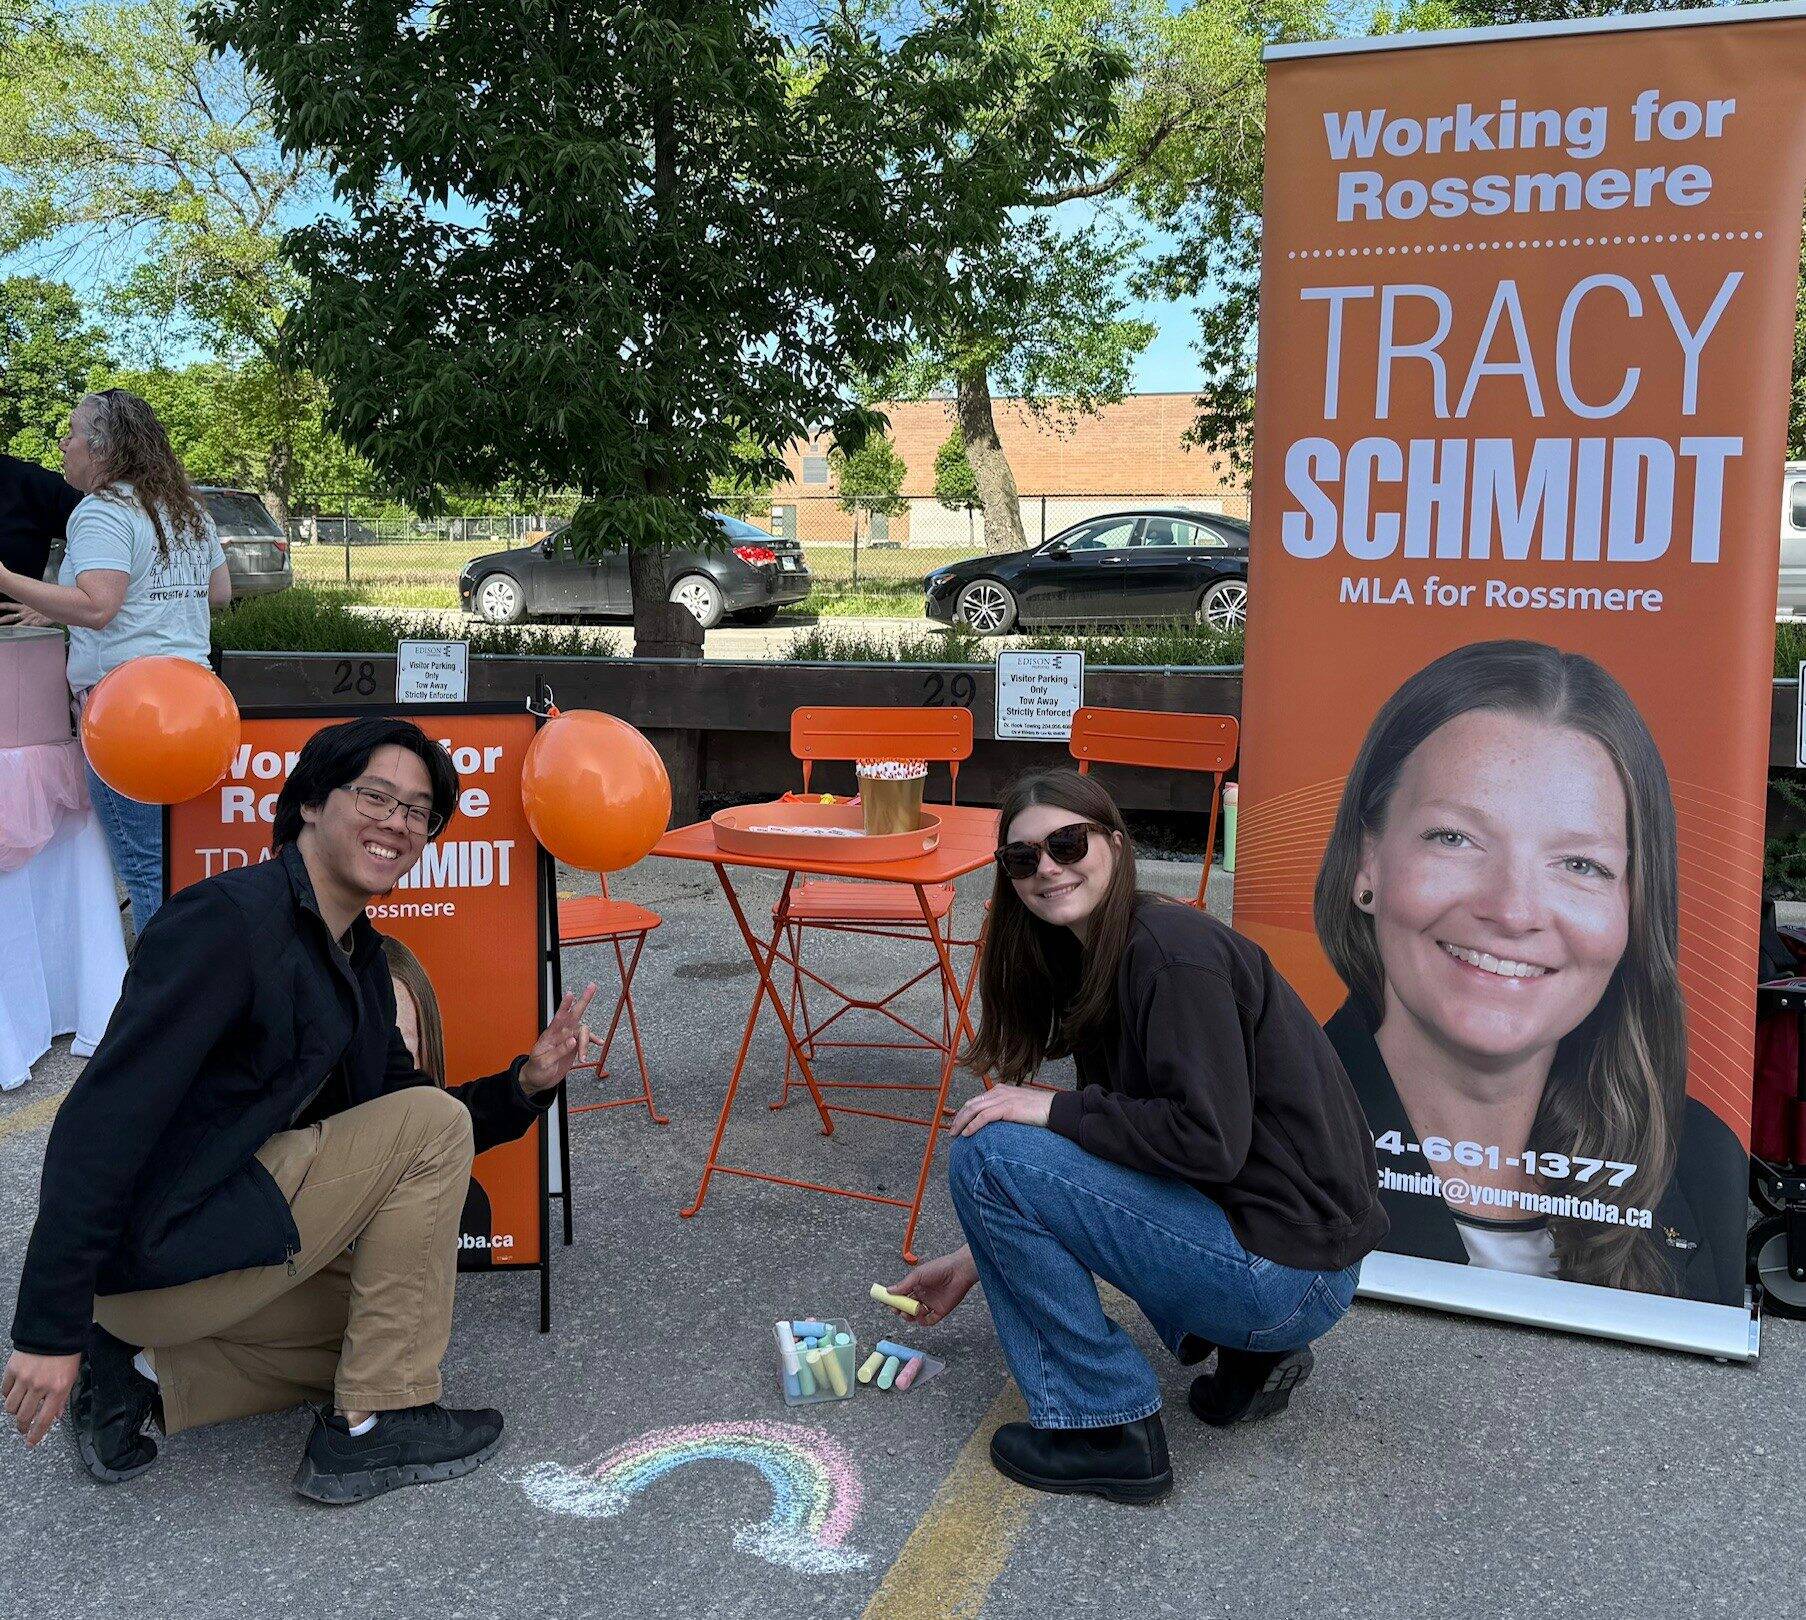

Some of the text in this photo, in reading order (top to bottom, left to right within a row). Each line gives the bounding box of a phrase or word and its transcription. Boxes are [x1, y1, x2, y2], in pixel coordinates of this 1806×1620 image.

[1323, 89, 1736, 160] Working for
[1336, 164, 1713, 222] Rossmere
[1300, 271, 1744, 420] TRACY
[1281, 436, 1744, 564] SCHMIDT
[1339, 575, 1664, 612] MLA for Rossmere
[409, 661, 456, 671] Visitor Parking
[1017, 657, 1050, 666] EDISON
[332, 660, 377, 696] 28
[424, 671, 440, 681] Only
[1010, 674, 1068, 685] Visitor Parking
[416, 681, 448, 691] Tow Away
[923, 672, 977, 707] 29
[1030, 685, 1048, 695] Only
[405, 690, 458, 700] Strictly Enforced
[1019, 696, 1059, 707] Tow Away
[1006, 707, 1071, 717] Strictly Enforced
[365, 902, 456, 919] ossmere
